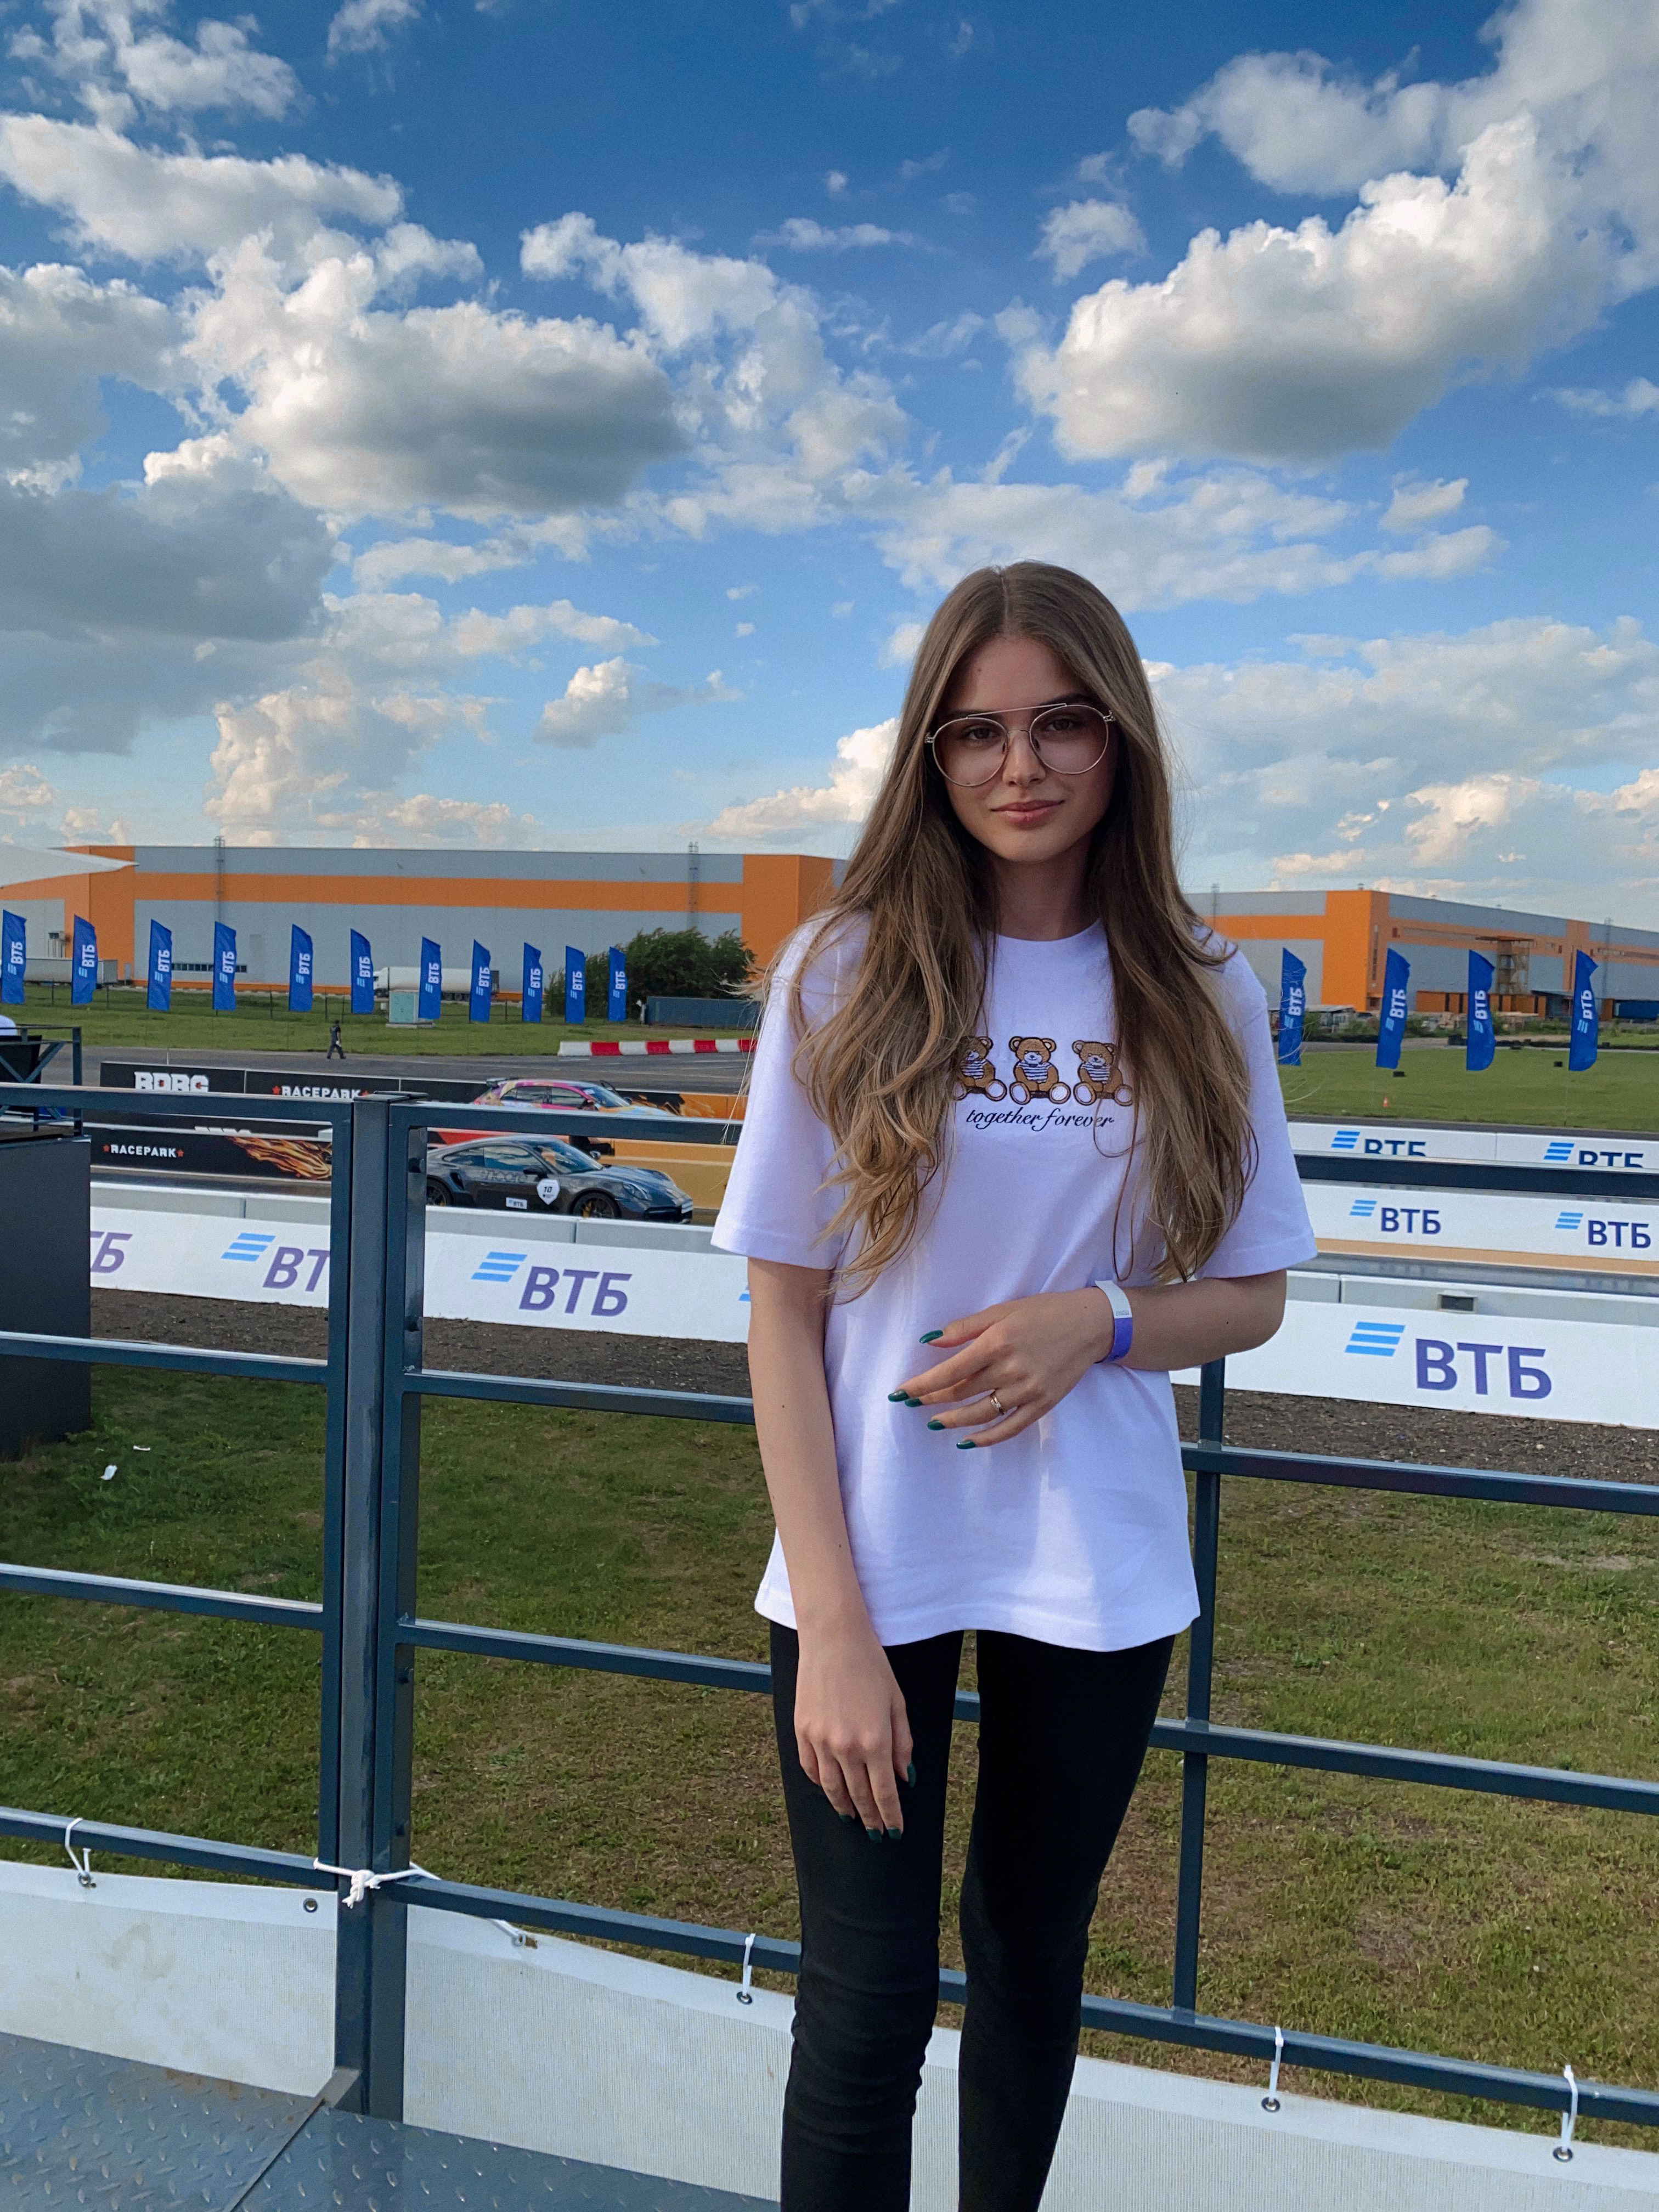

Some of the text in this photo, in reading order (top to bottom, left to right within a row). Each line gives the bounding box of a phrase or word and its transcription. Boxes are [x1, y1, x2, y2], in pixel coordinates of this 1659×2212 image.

[10, 941, 24, 965] ВТБ
[81, 944, 95, 968] ВТБ
[157, 950, 170, 972] ВТБ
[222, 951, 235, 974] ВТБ
[298, 952, 311, 975] ВТБ
[359, 956, 371, 978] ВТБ
[428, 962, 439, 984] ВТБ
[478, 966, 490, 988] ВТБ
[530, 968, 541, 989] ВТБ
[572, 970, 583, 991] ВТБ
[615, 970, 625, 990] ВТБ
[1289, 987, 1303, 1016] ВТБ
[1390, 989, 1407, 1019] ВТБ
[1475, 990, 1488, 1020] ВТБ
[1581, 990, 1593, 1020] ВТБ
[281, 1085, 362, 1099] RACEPARK
[966, 1107, 1115, 1132] together forever
[110, 1144, 176, 1158] RACEPARK
[1380, 1207, 1441, 1234] ВТБ
[1588, 1220, 1651, 1249] ВТБ
[262, 1246, 330, 1292] ВТ
[518, 1266, 633, 1317] ВТБ
[1415, 1338, 1553, 1400] ВТБ
